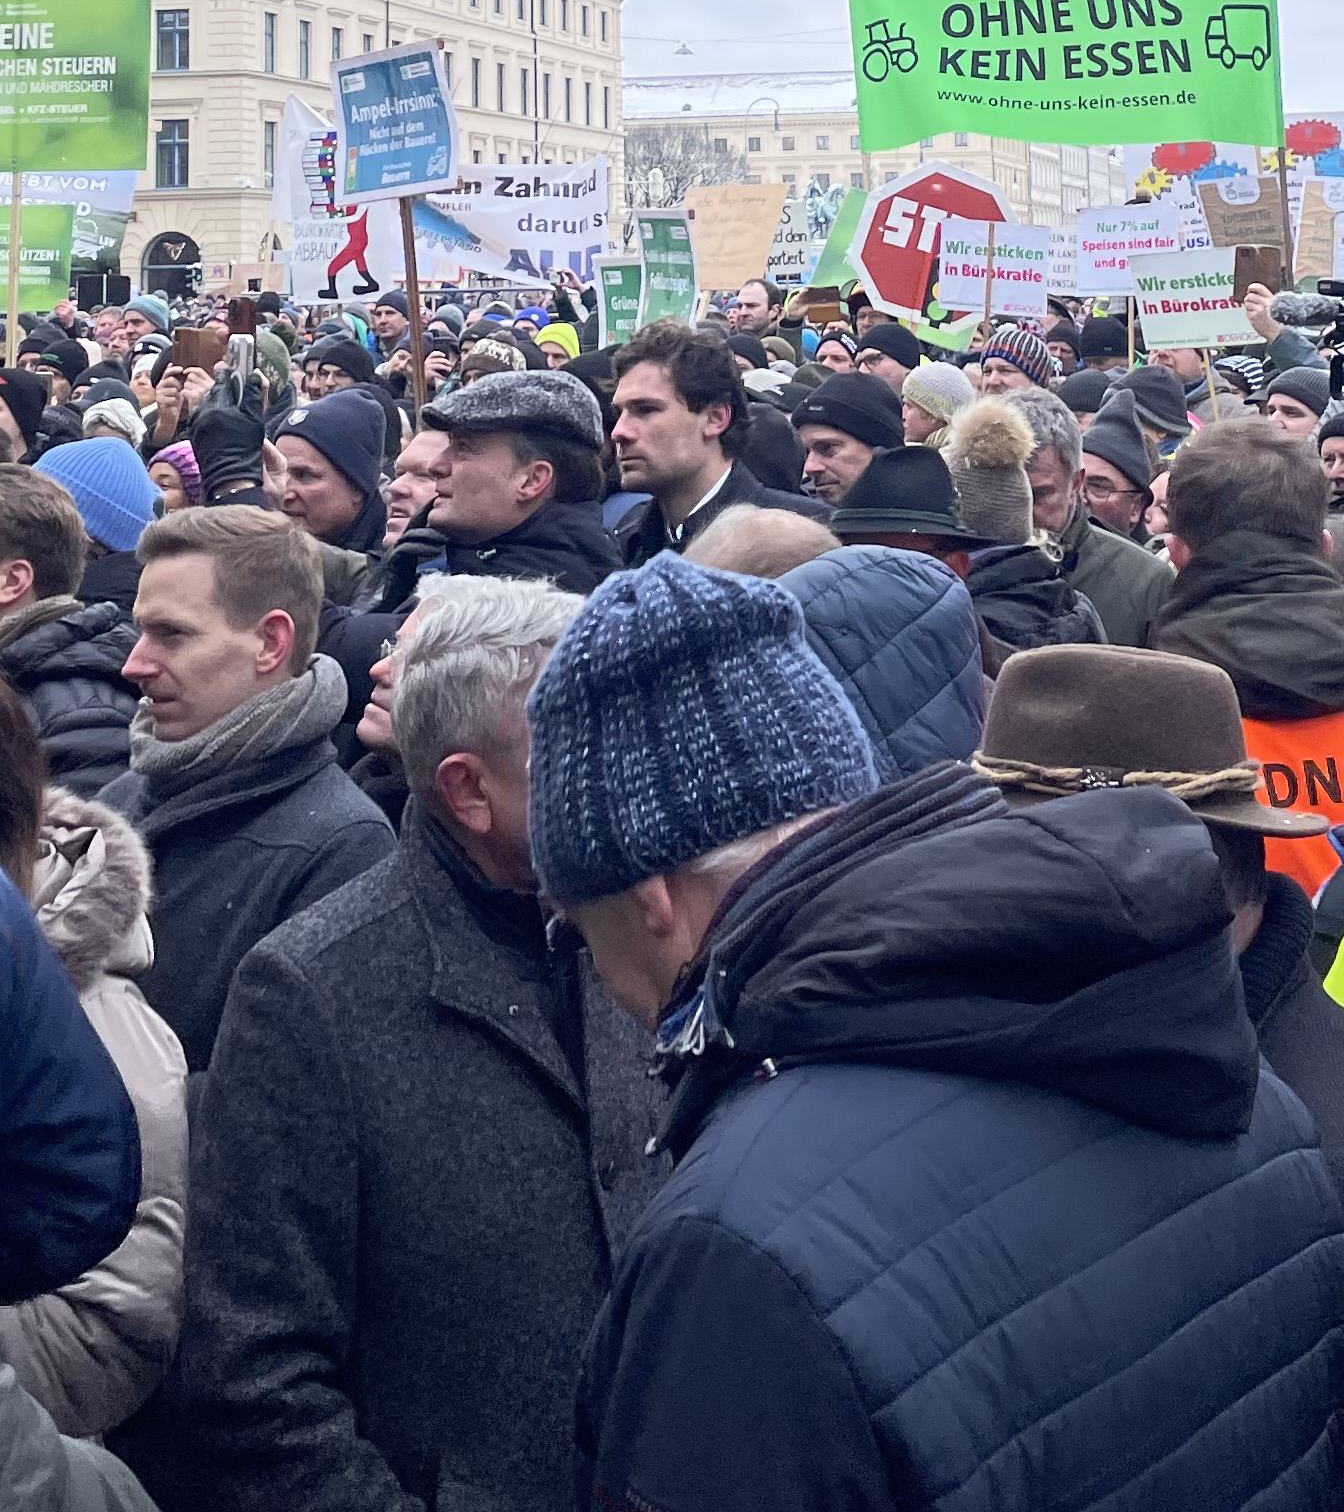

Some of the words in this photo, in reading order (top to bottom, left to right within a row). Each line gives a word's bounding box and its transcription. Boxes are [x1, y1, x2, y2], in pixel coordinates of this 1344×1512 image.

[41, 56, 117, 77] STEUERN
[938, 46, 1045, 82] KEIN
[1063, 38, 1192, 80] ESSEN
[6, 81, 27, 95] UND
[936, 89, 1197, 111] www.ohne-uns-kein-essen.de
[59, 176, 108, 192] VOM
[1096, 222, 1117, 233] Nur
[1120, 221, 1138, 232] 7%
[1141, 219, 1160, 231] auf
[946, 241, 971, 254] Wir
[1082, 238, 1126, 253] Speisen
[1128, 238, 1152, 249] sind
[1155, 236, 1175, 248] fair
[945, 261, 958, 275] in
[1094, 258, 1116, 268] und
[1137, 277, 1167, 291] Wir
[1170, 272, 1235, 289] ersticke
[1143, 300, 1158, 315] in
